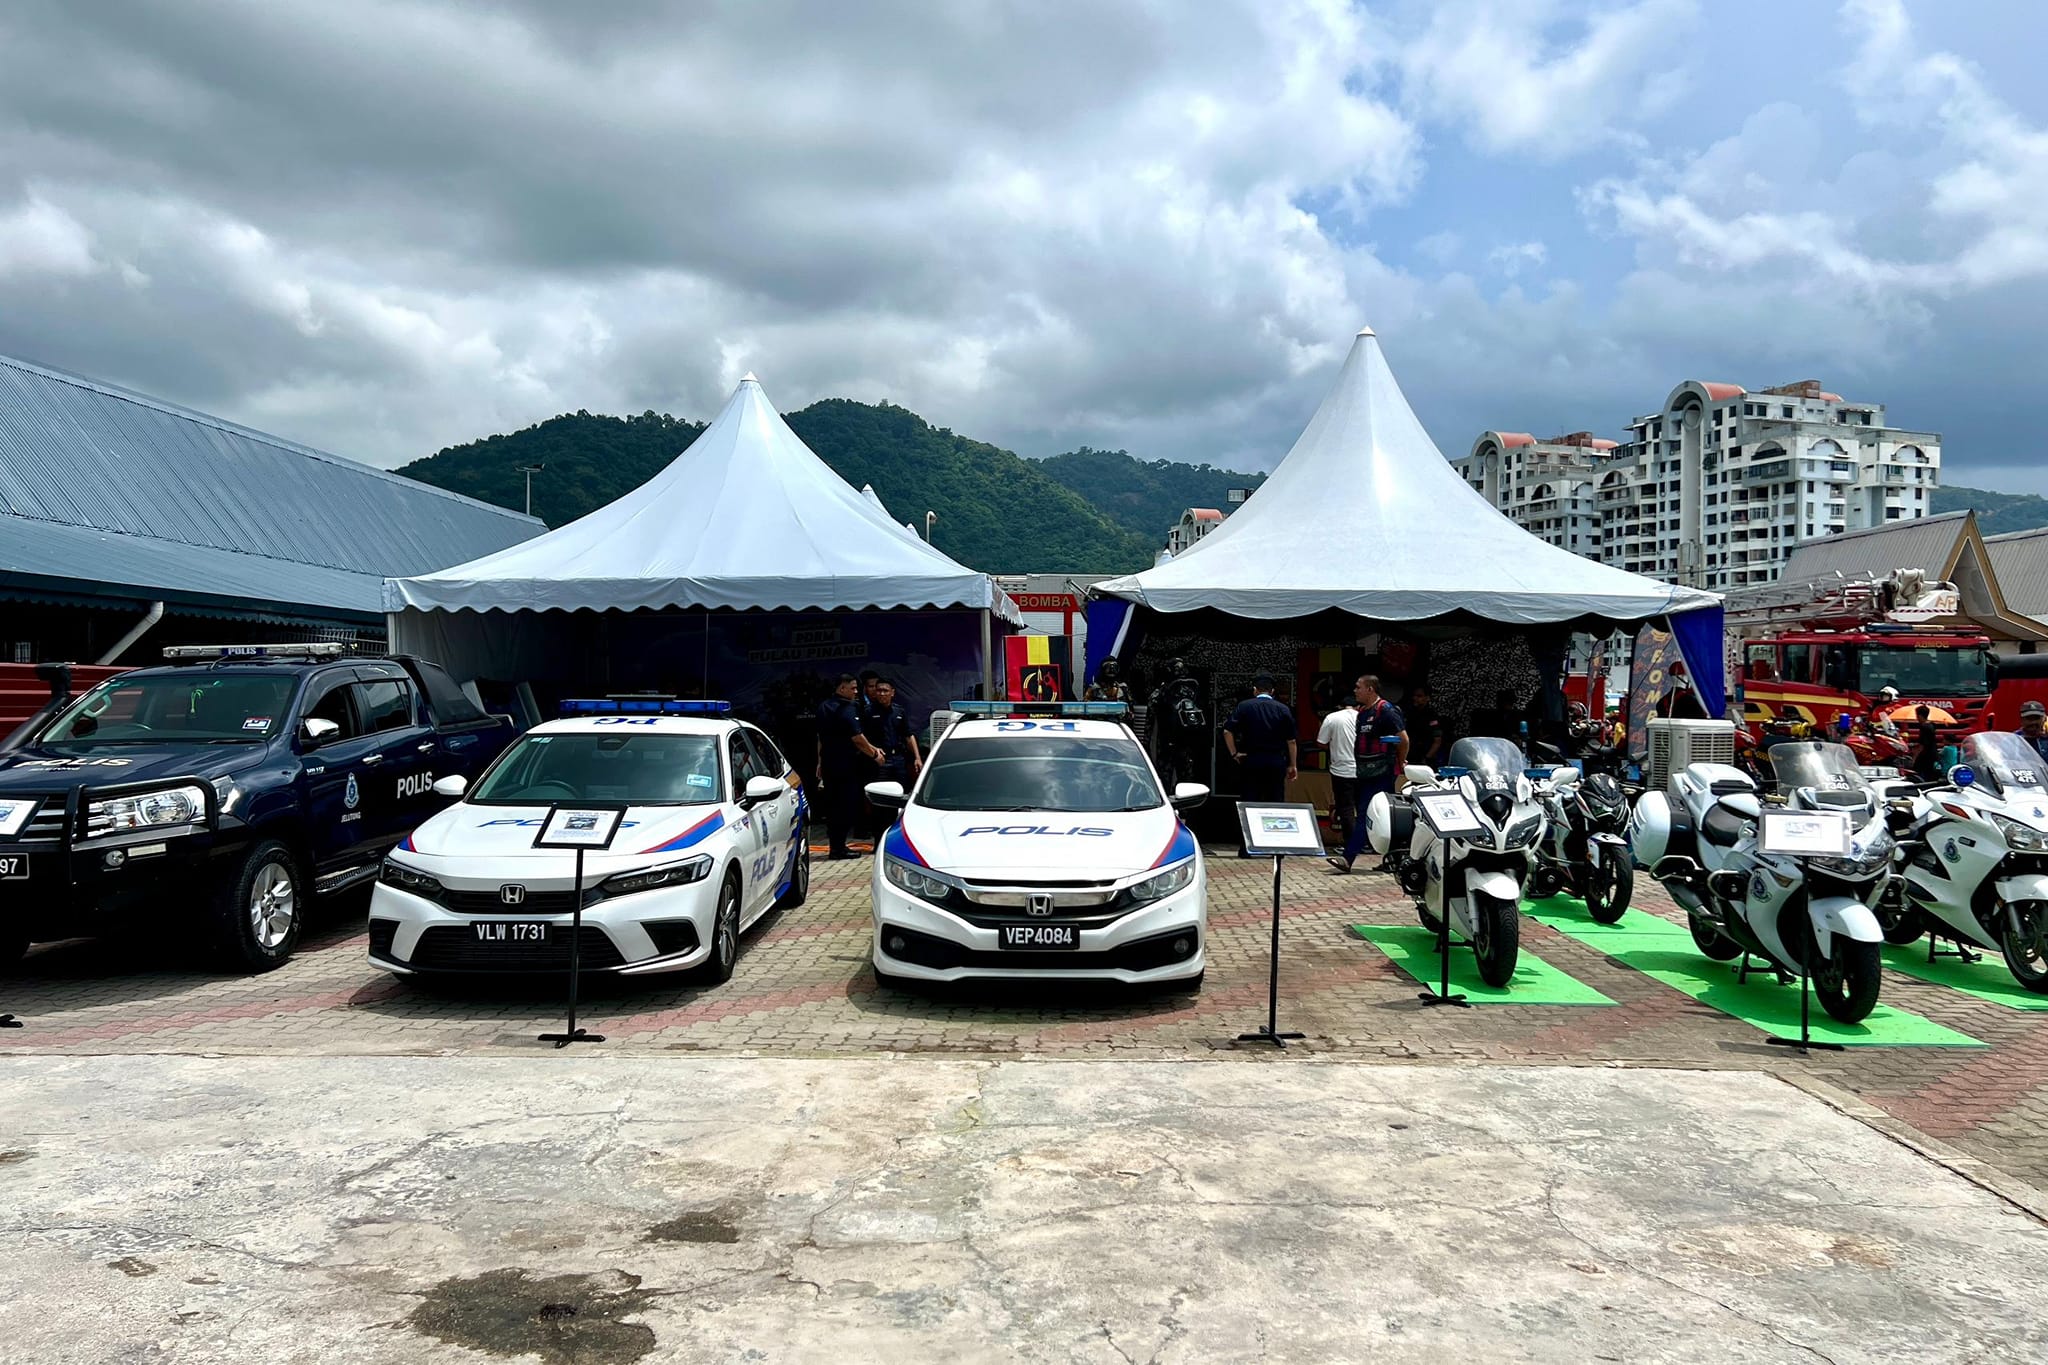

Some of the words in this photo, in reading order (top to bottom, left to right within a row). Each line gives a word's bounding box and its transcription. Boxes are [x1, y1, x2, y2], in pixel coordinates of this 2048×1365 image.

[1019, 596, 1071, 607] BOMBA
[227, 647, 257, 656] POLIS
[806, 644, 866, 659] PINANG
[12, 758, 133, 768] POLIS
[397, 771, 433, 799] POLIS
[959, 826, 1115, 837] POLIS
[750, 846, 777, 888] POLIS
[476, 924, 507, 940] VLW
[512, 924, 545, 940] 1731
[1006, 928, 1073, 944] VEP4084
